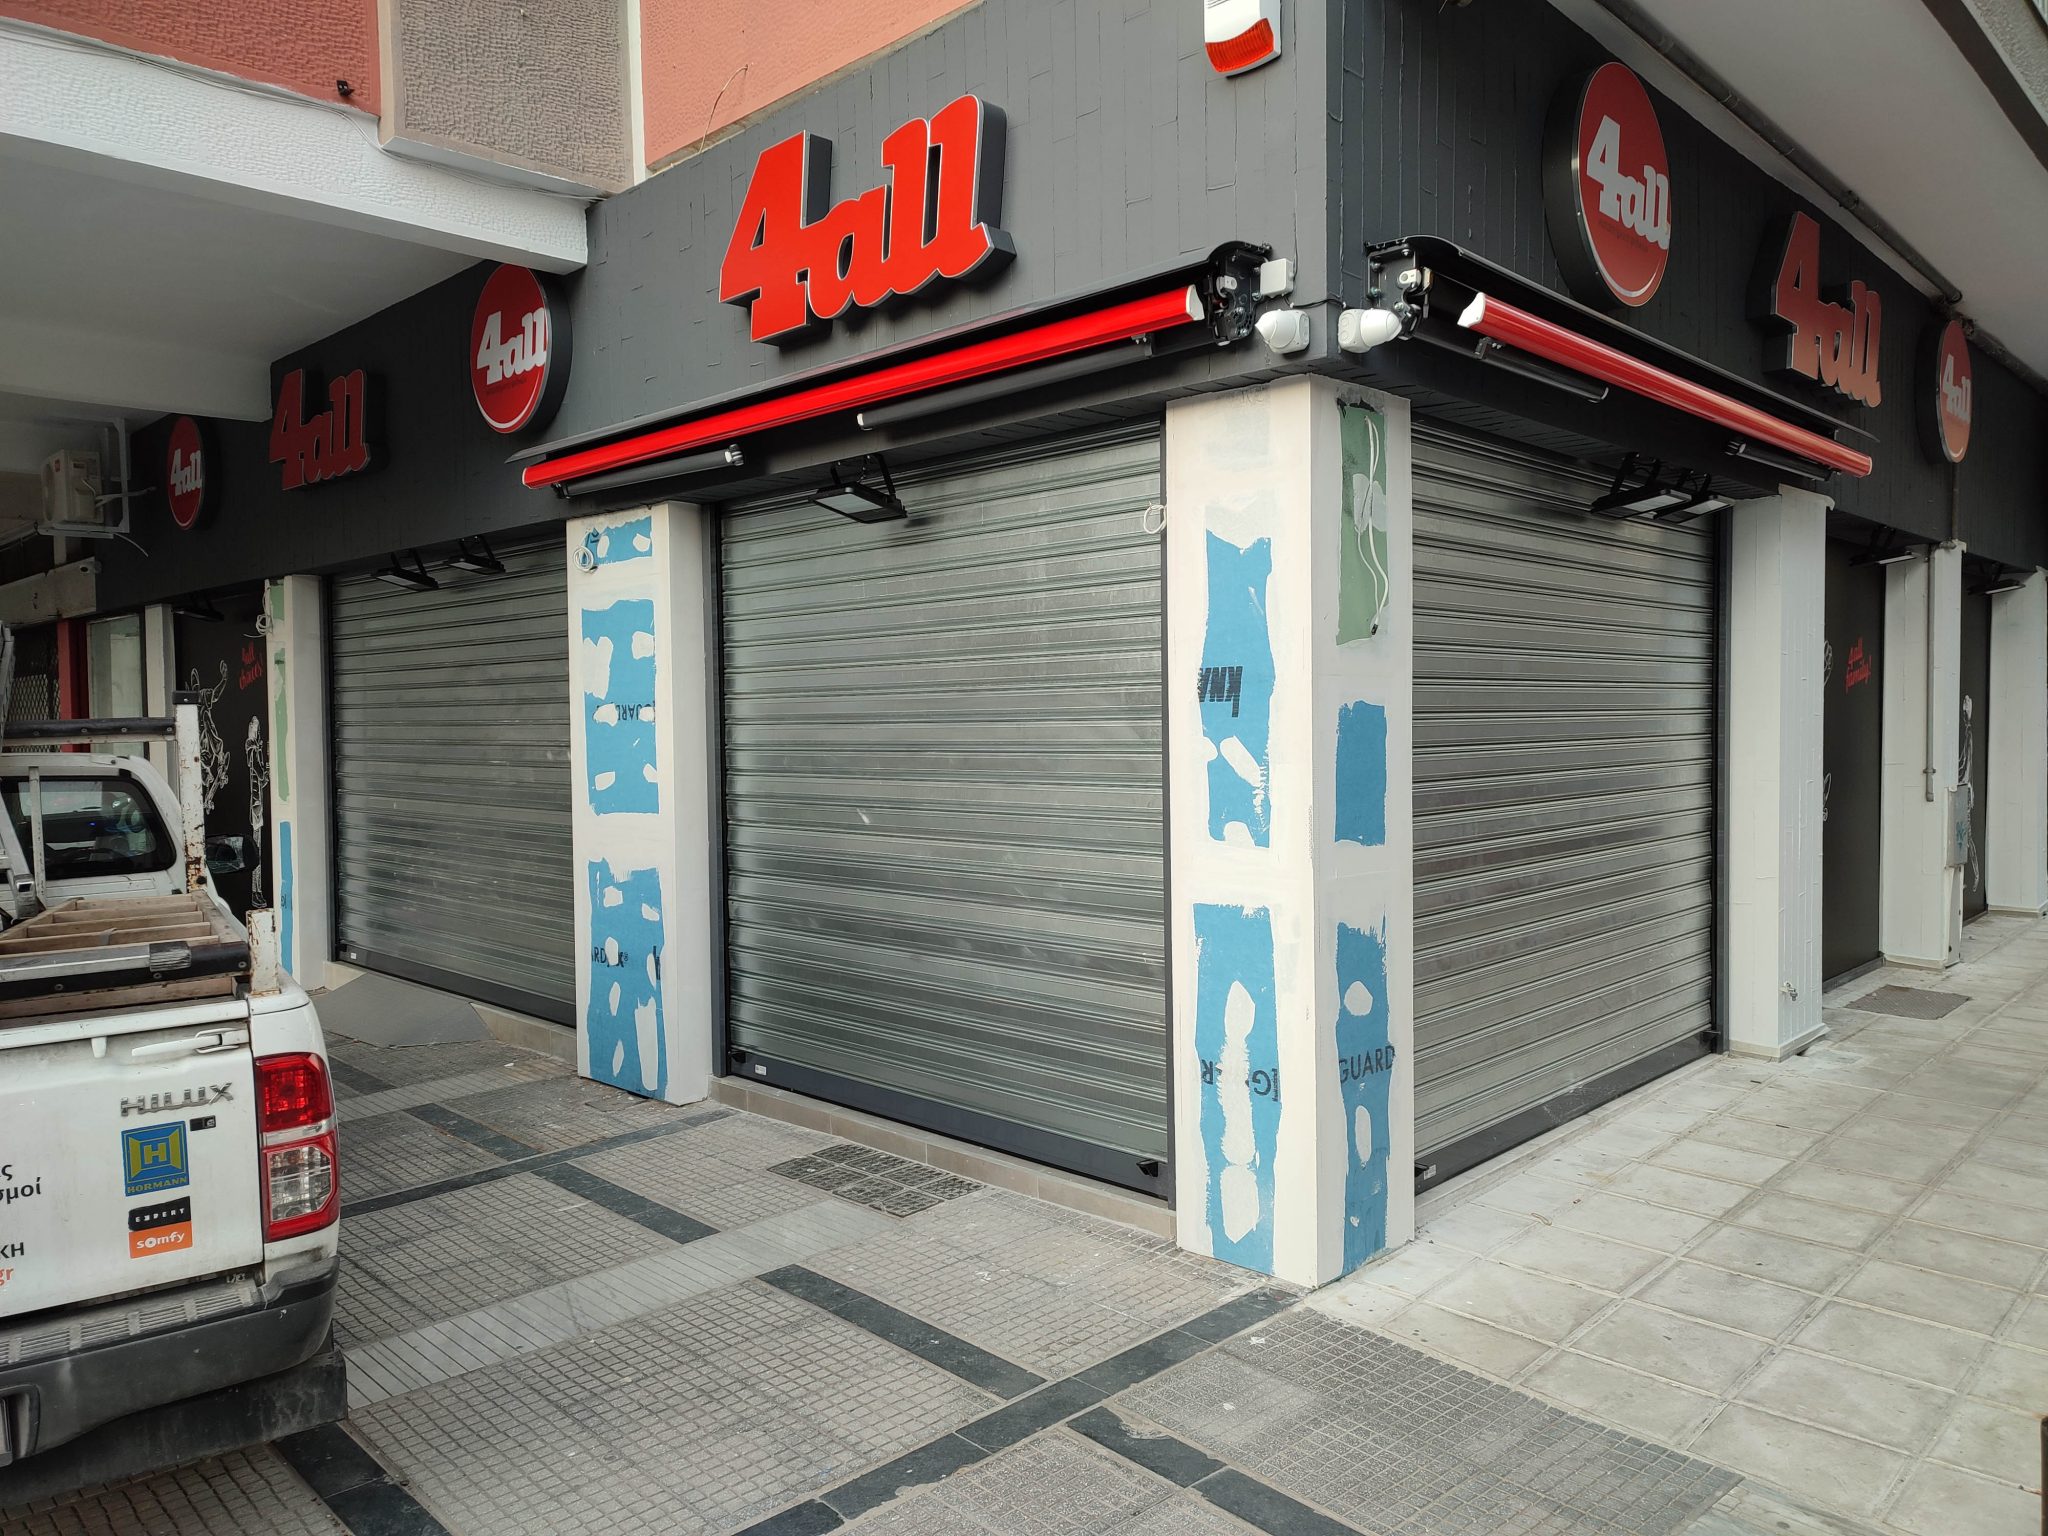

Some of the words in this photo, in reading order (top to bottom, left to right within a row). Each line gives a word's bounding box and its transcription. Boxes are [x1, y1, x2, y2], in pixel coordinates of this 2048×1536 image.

[719, 94, 992, 342] 4all
[1587, 114, 1671, 250] 4all
[477, 307, 547, 385] 4all
[1775, 211, 1882, 408] 4all
[1942, 353, 1971, 422] 4all
[269, 368, 369, 490] 4all
[170, 448, 202, 496] 4all
[120, 1082, 234, 1117] HILUX
[136, 1231, 185, 1249] somfy
